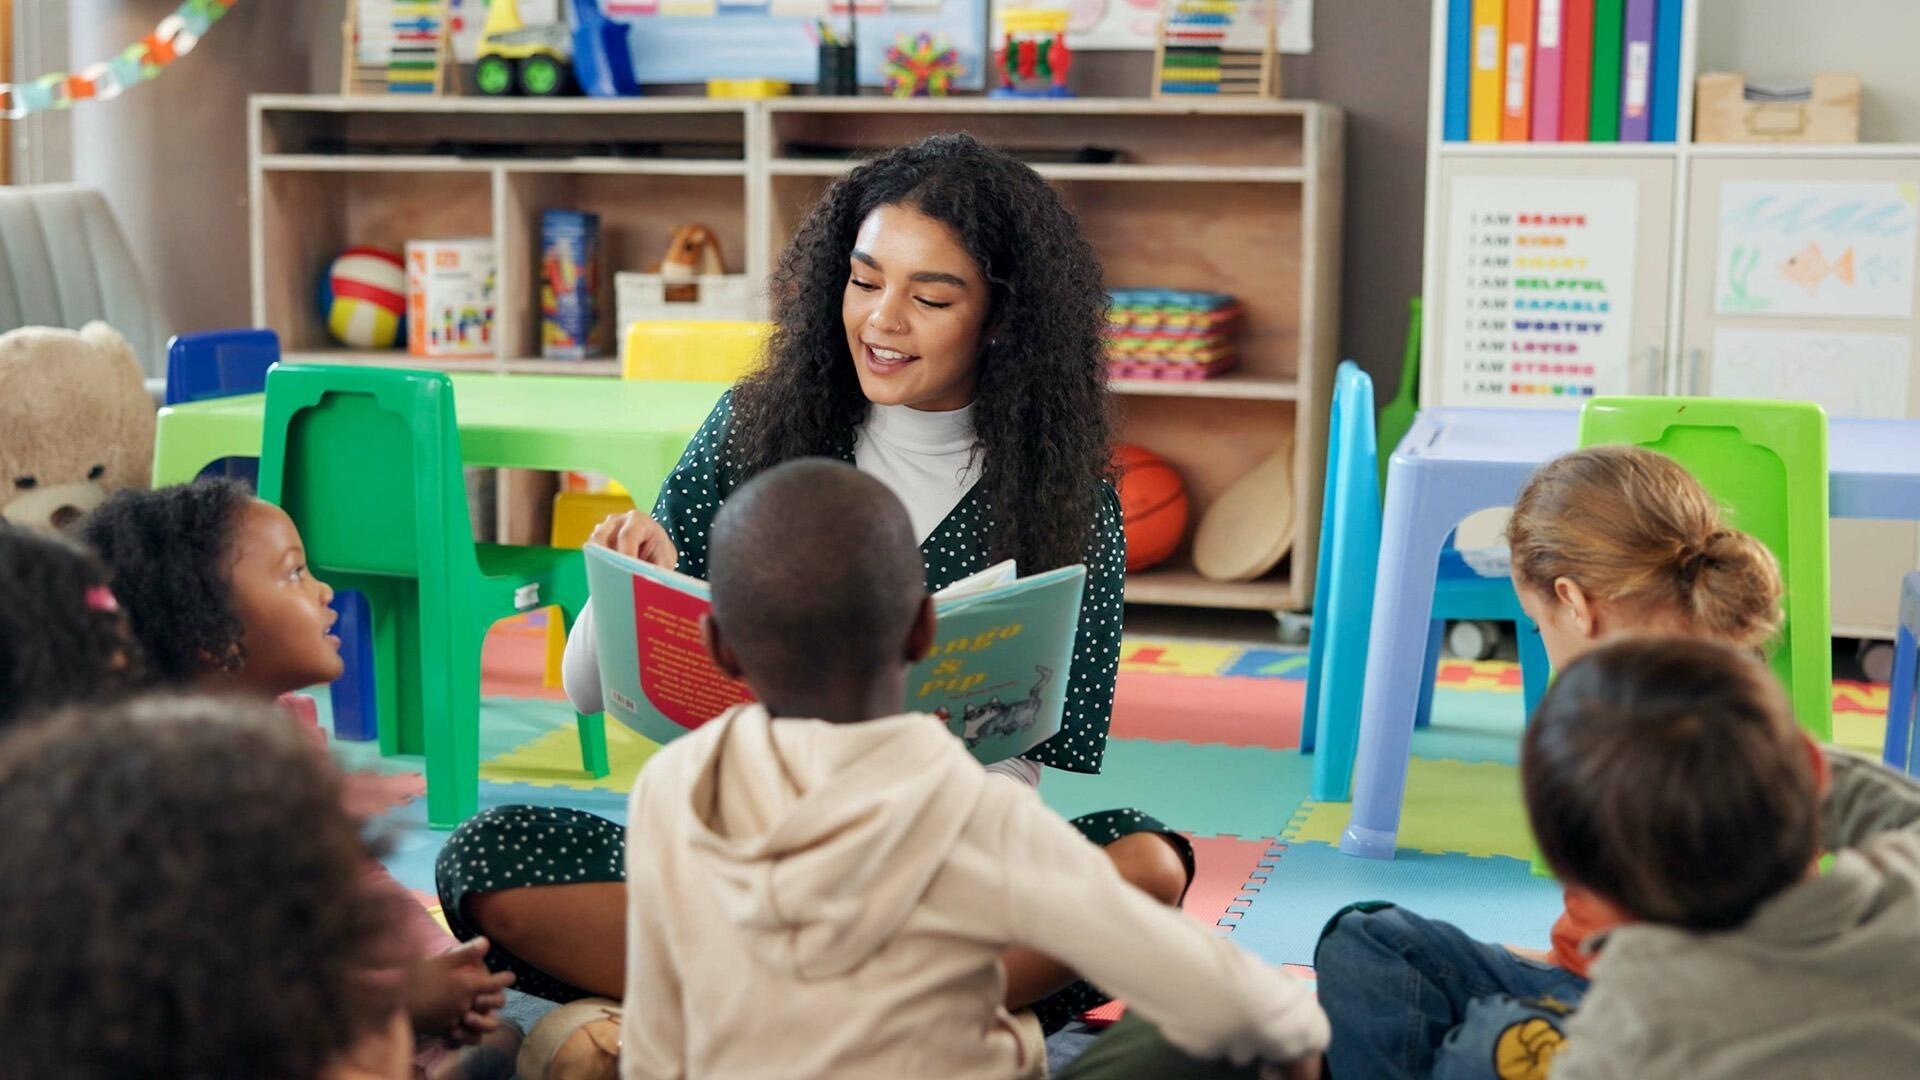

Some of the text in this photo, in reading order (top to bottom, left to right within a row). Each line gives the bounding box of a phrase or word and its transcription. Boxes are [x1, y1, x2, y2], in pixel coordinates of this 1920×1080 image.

[1482, 214, 1510, 225] AM
[1517, 214, 1586, 226] BRAVE
[1481, 235, 1509, 246] AM
[1481, 256, 1509, 267] AM
[1480, 278, 1508, 289] AM
[1514, 278, 1605, 291] HELPFUL
[1479, 299, 1507, 309] AM
[1514, 299, 1610, 312] CAPABLE
[1479, 319, 1506, 330] AM
[1513, 320, 1603, 332] WORTHY
[1478, 341, 1505, 352] AM
[1512, 342, 1578, 354] LOVED
[1477, 362, 1504, 373] AM
[1511, 363, 1595, 376] STRONG
[1477, 382, 1503, 393] AM
